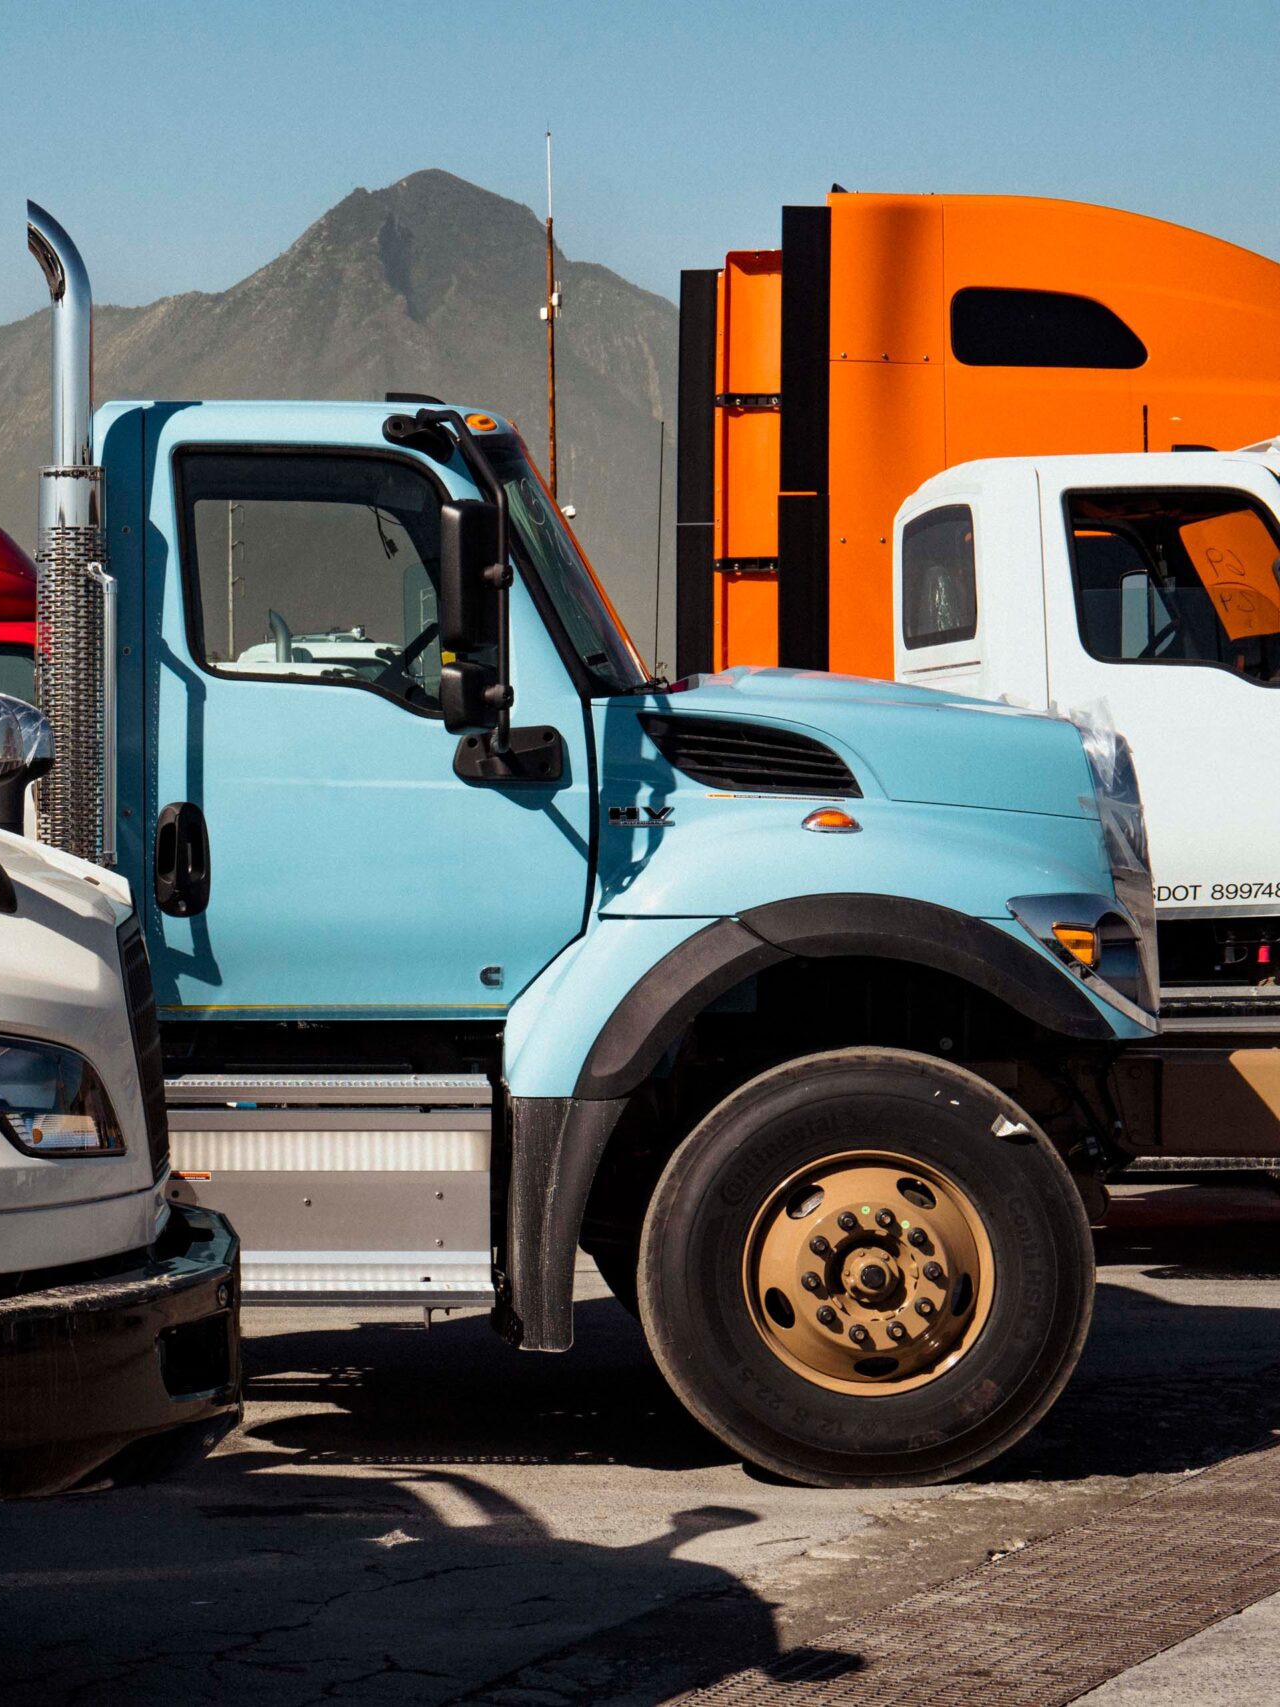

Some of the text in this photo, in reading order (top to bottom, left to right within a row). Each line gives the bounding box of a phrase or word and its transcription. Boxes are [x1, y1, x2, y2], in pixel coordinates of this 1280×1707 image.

[608, 806, 674, 820] HV
[1152, 884, 1202, 902] DOT
[719, 1111, 839, 1207] Continental
